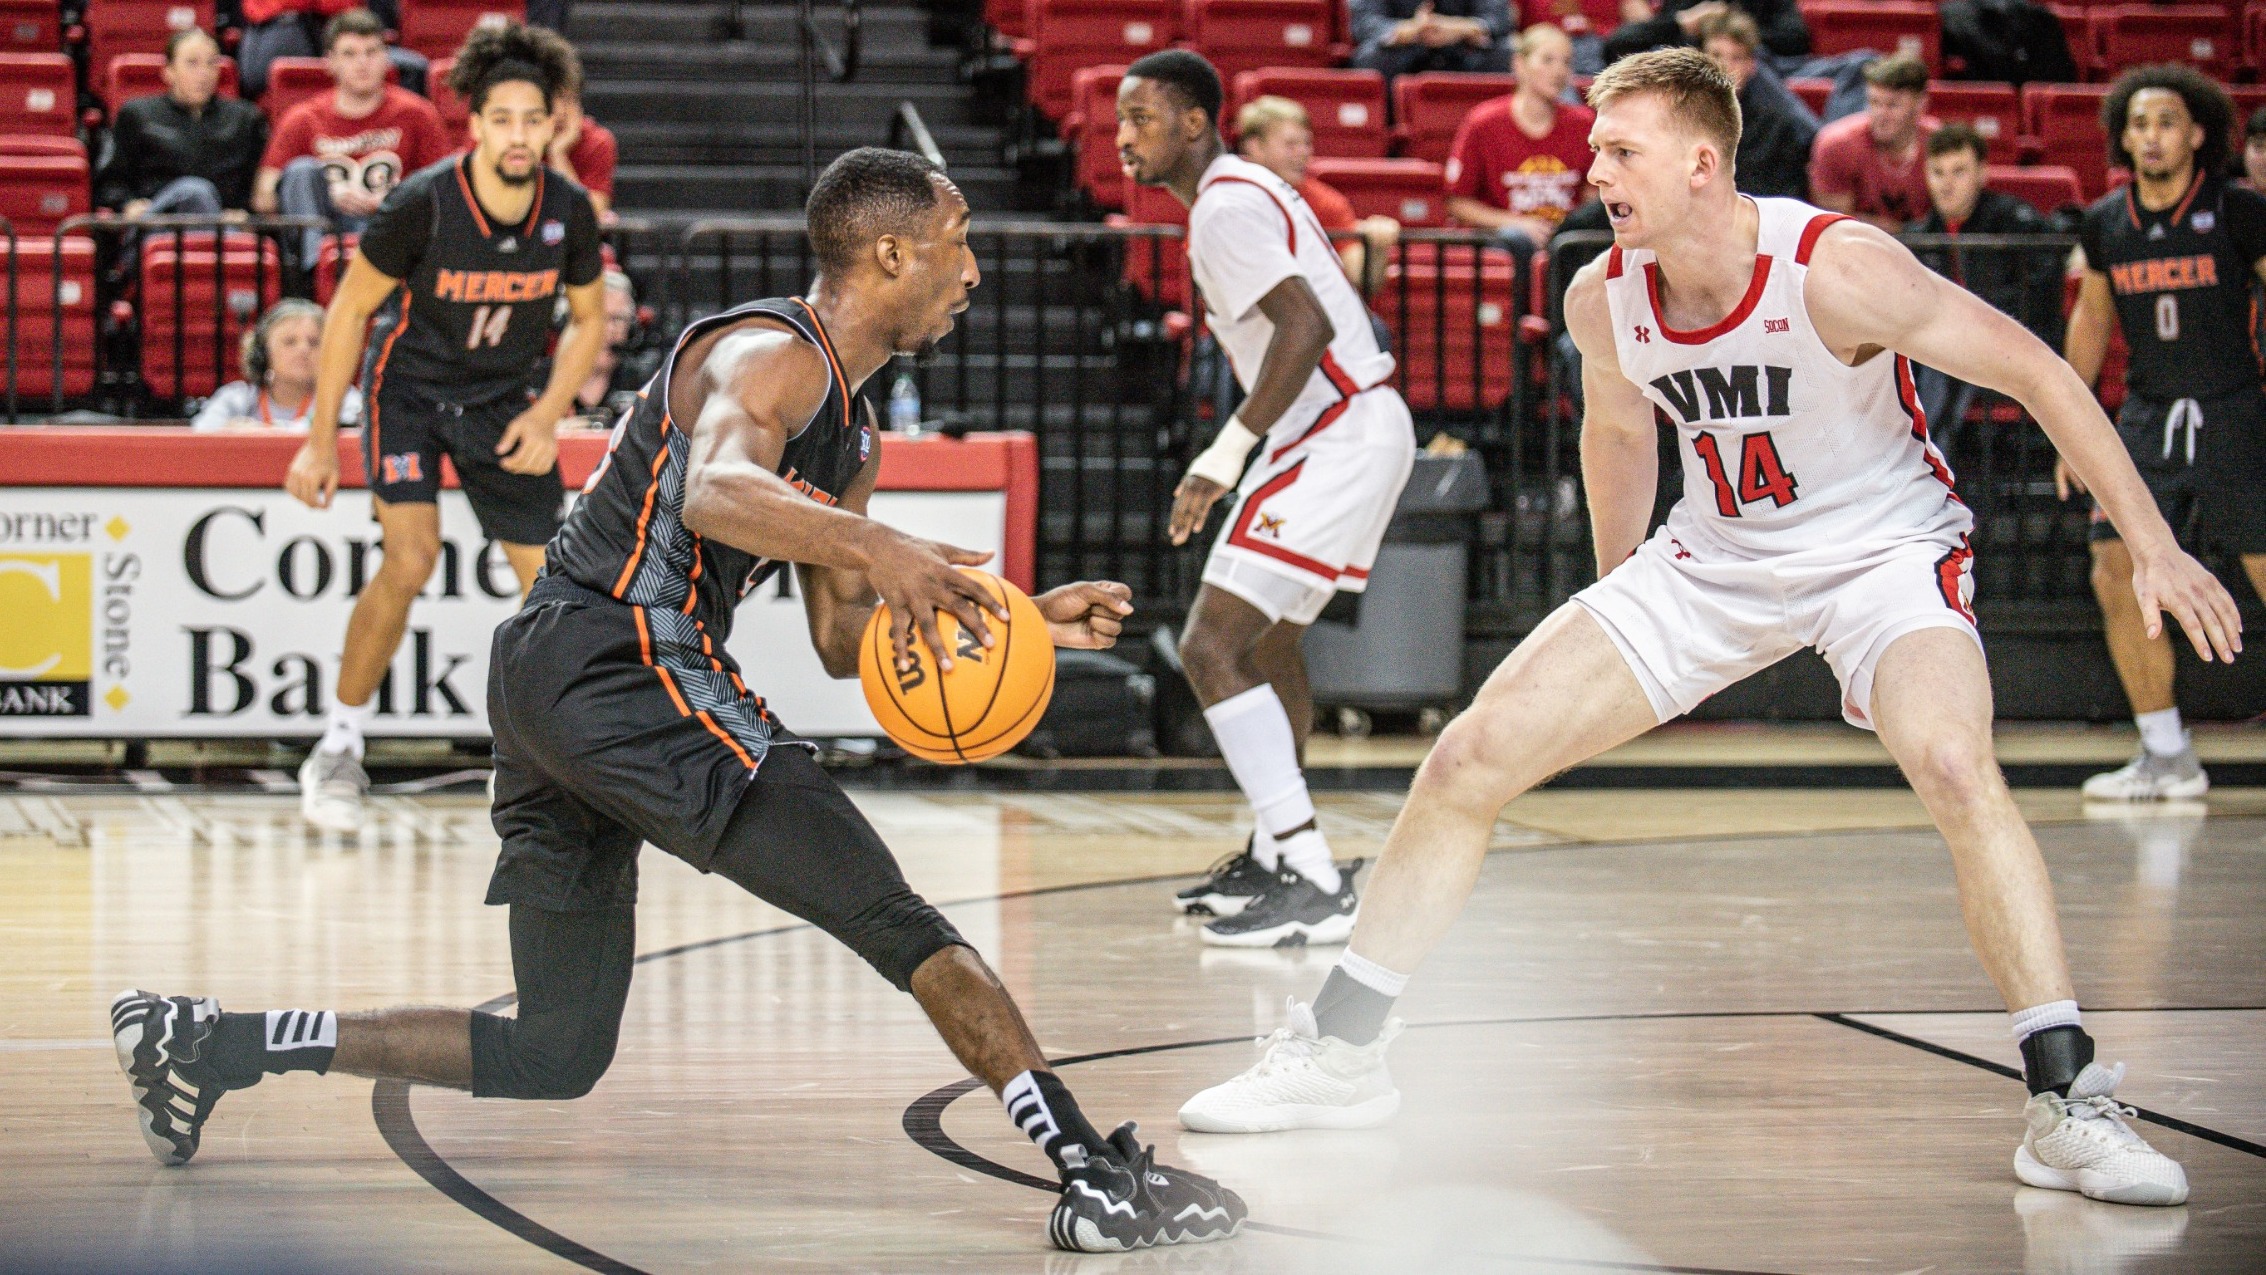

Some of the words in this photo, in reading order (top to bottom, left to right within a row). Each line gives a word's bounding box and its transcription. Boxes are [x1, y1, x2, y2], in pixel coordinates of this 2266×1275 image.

[435, 268, 559, 303] MERCER
[2110, 254, 2219, 295] MERCER
[467, 305, 512, 349] 14
[2156, 294, 2180, 341] 0
[1648, 365, 1792, 423] VMI
[1691, 430, 1799, 517] 14
[105, 552, 141, 678] Stone
